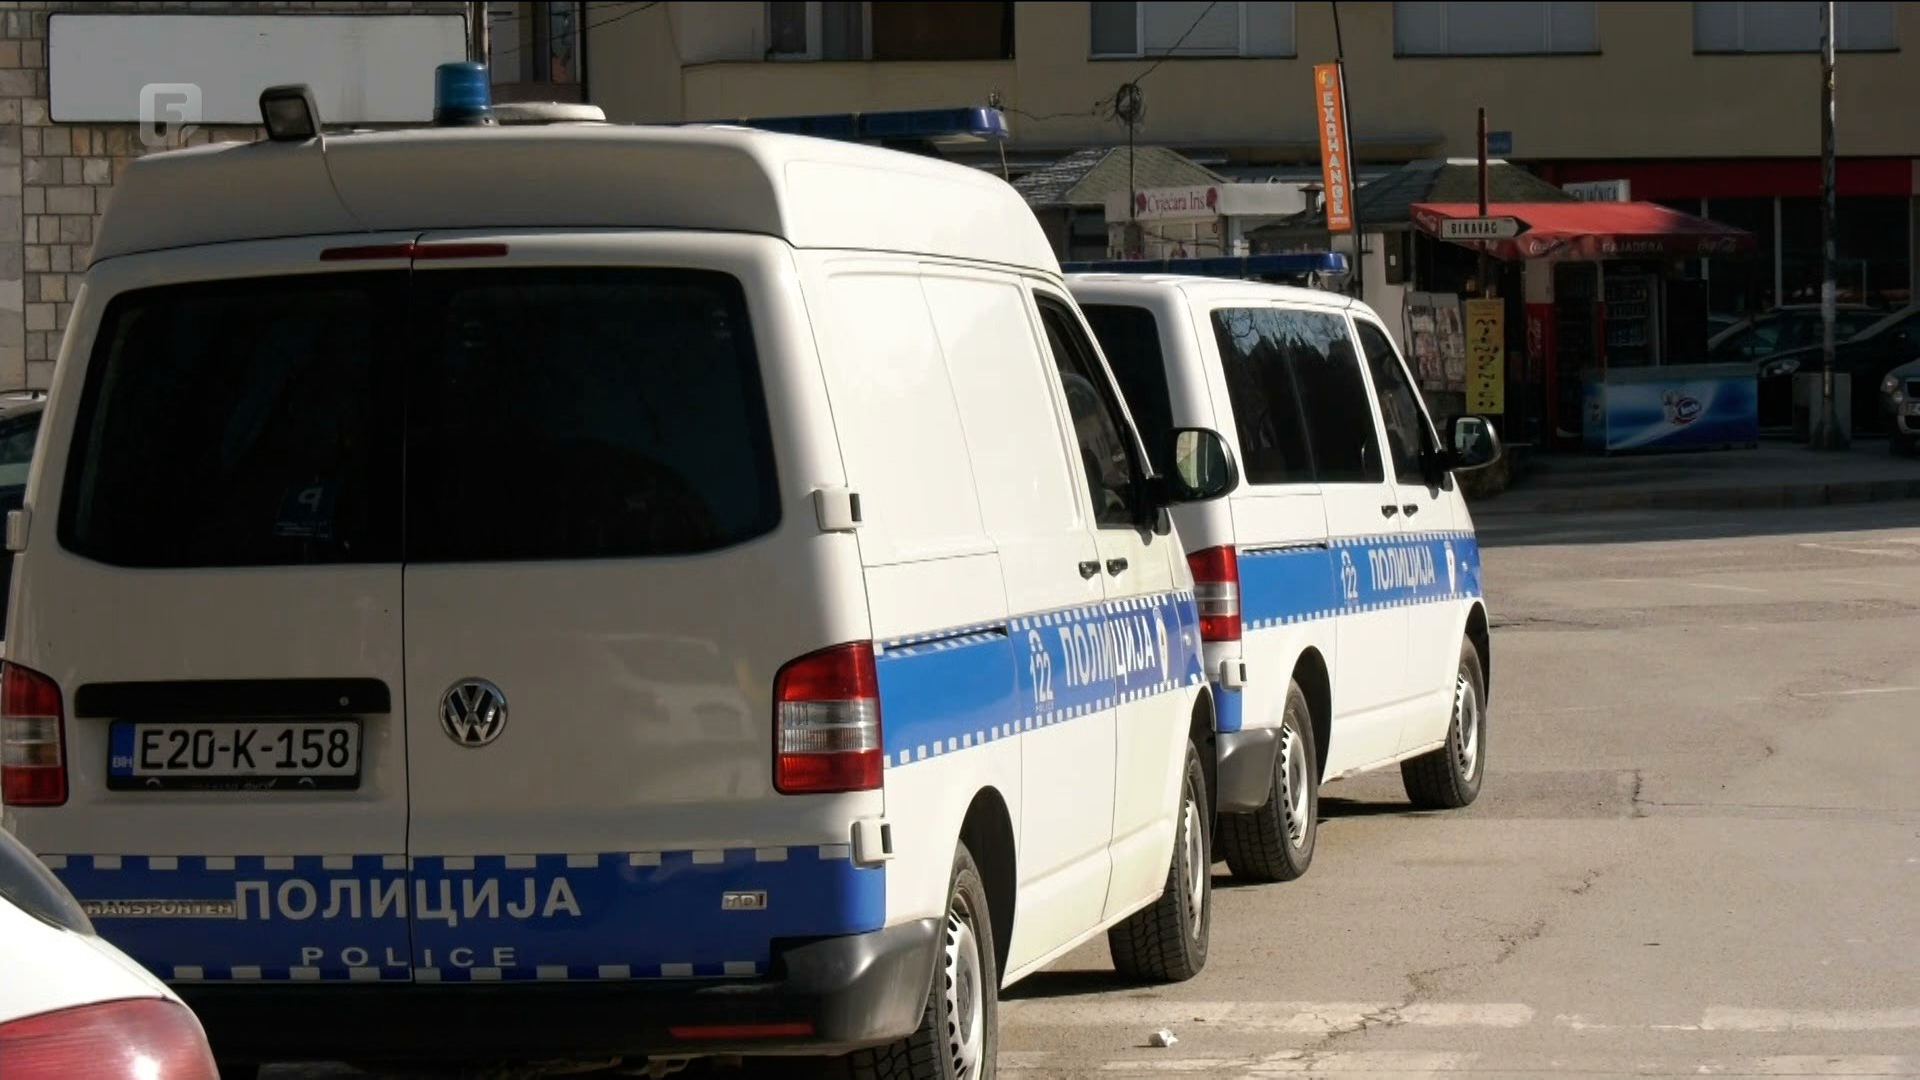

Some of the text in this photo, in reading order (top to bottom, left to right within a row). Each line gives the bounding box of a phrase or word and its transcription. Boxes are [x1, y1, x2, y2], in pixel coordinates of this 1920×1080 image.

[1368, 545, 1436, 594] ПОЛИЦИЈА
[1058, 615, 1156, 688] ПОЛИЦИЈА
[1029, 651, 1054, 704] 122
[141, 729, 349, 769] E20-K-158
[83, 901, 233, 915] RANSPORTER
[235, 877, 582, 928] ПОЛИЦИЈА
[724, 893, 764, 907] TDI
[301, 946, 518, 968] POLICE
